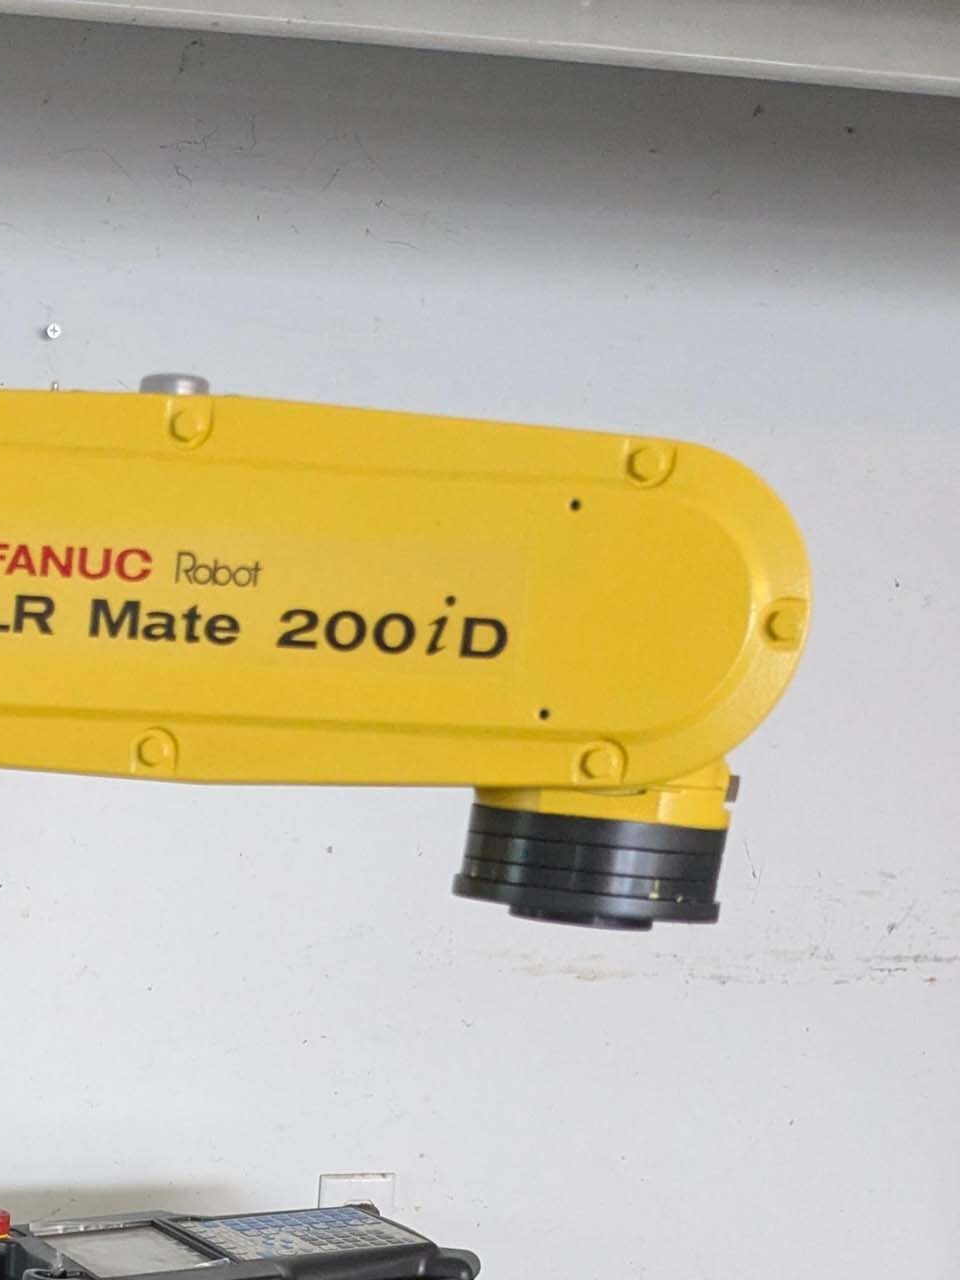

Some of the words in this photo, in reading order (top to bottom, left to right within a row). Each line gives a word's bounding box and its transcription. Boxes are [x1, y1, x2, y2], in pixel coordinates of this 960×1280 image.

[174, 551, 263, 588] Robot
[88, 598, 240, 645] Mate
[276, 596, 509, 659] 200iD
